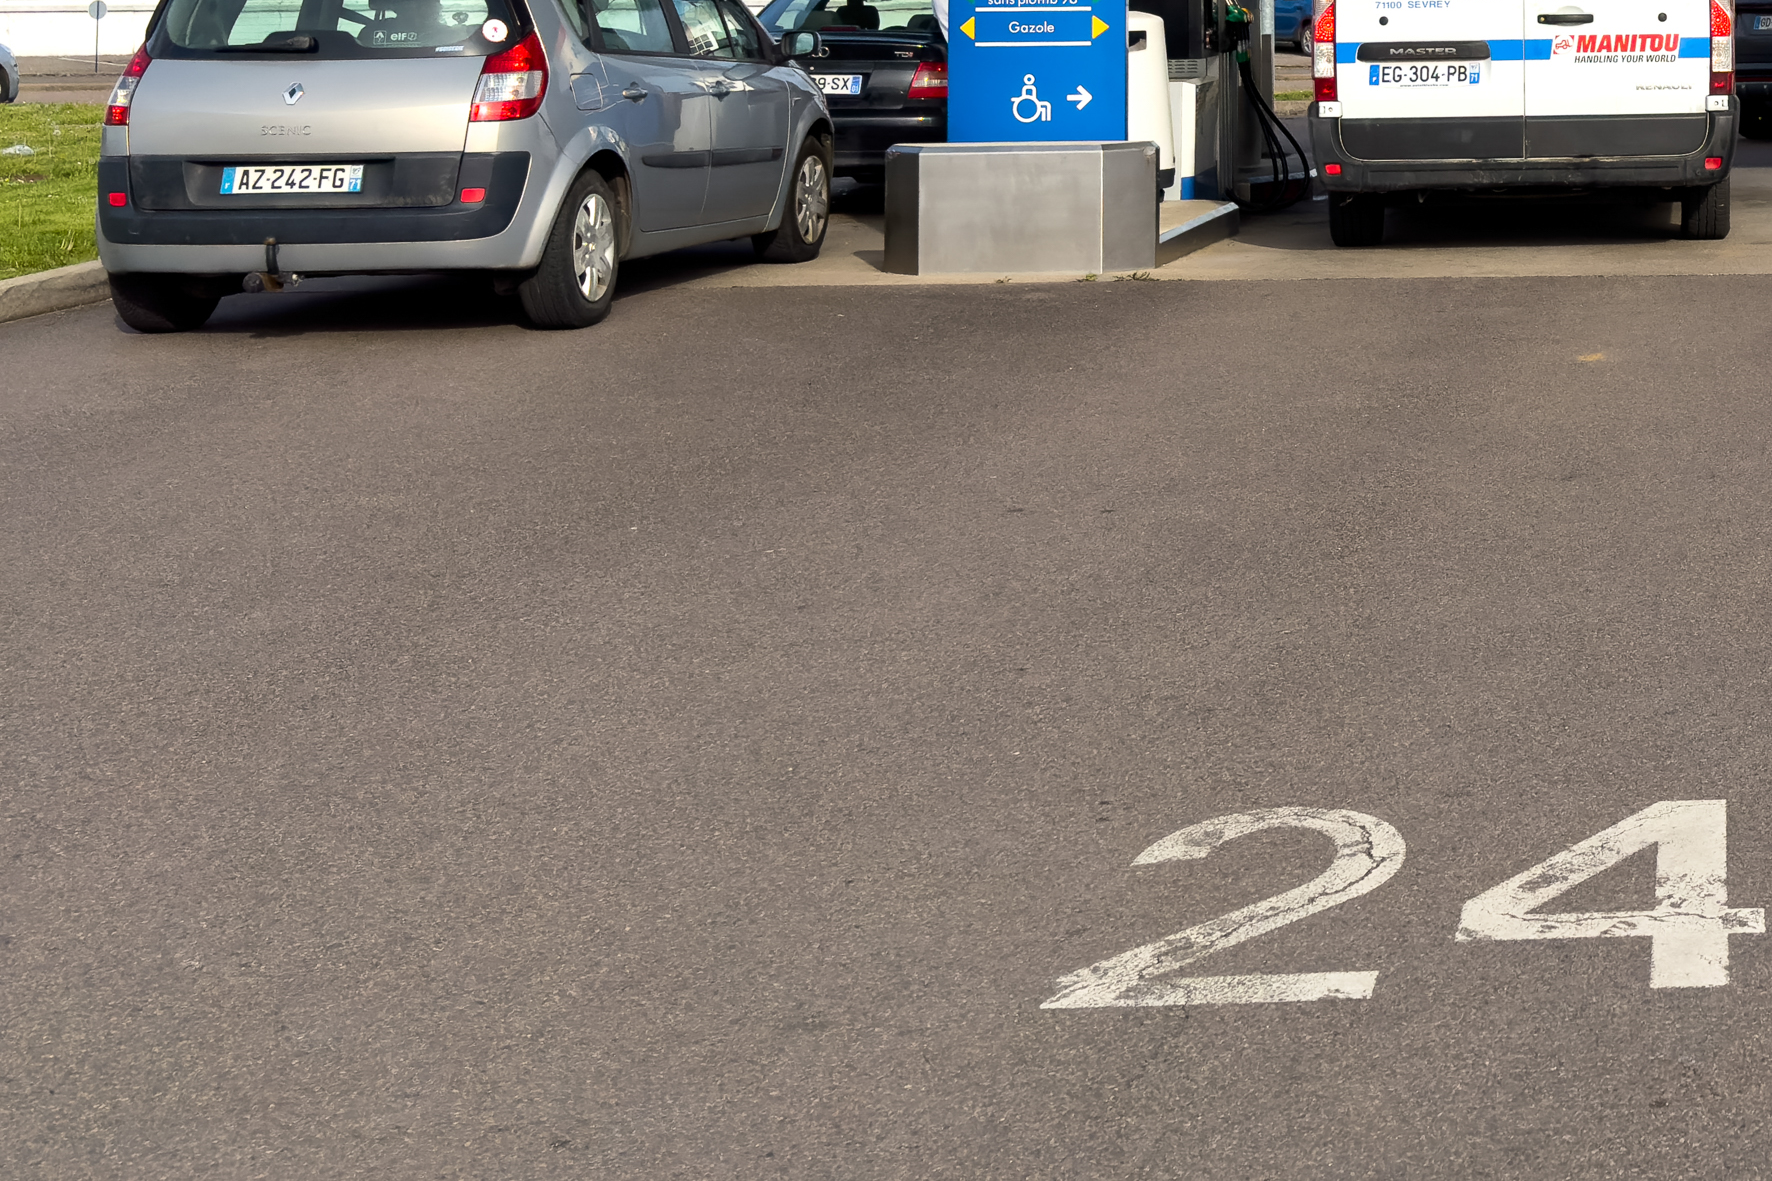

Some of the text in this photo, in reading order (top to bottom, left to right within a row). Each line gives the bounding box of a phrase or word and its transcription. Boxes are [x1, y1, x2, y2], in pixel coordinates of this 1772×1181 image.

[1375, 0, 1451, 9] 71100 SEVREY
[1008, 21, 1055, 34] Gazole
[390, 31, 408, 41] elf
[1576, 34, 1679, 53] MANITOU
[1389, 47, 1457, 56] MASTER
[1574, 54, 1677, 63] HANDLING YOUR WORLD
[1381, 65, 1468, 83] EG-304-PB
[260, 125, 312, 137] SCENIC
[238, 167, 361, 190] AZ-242-FG 71
